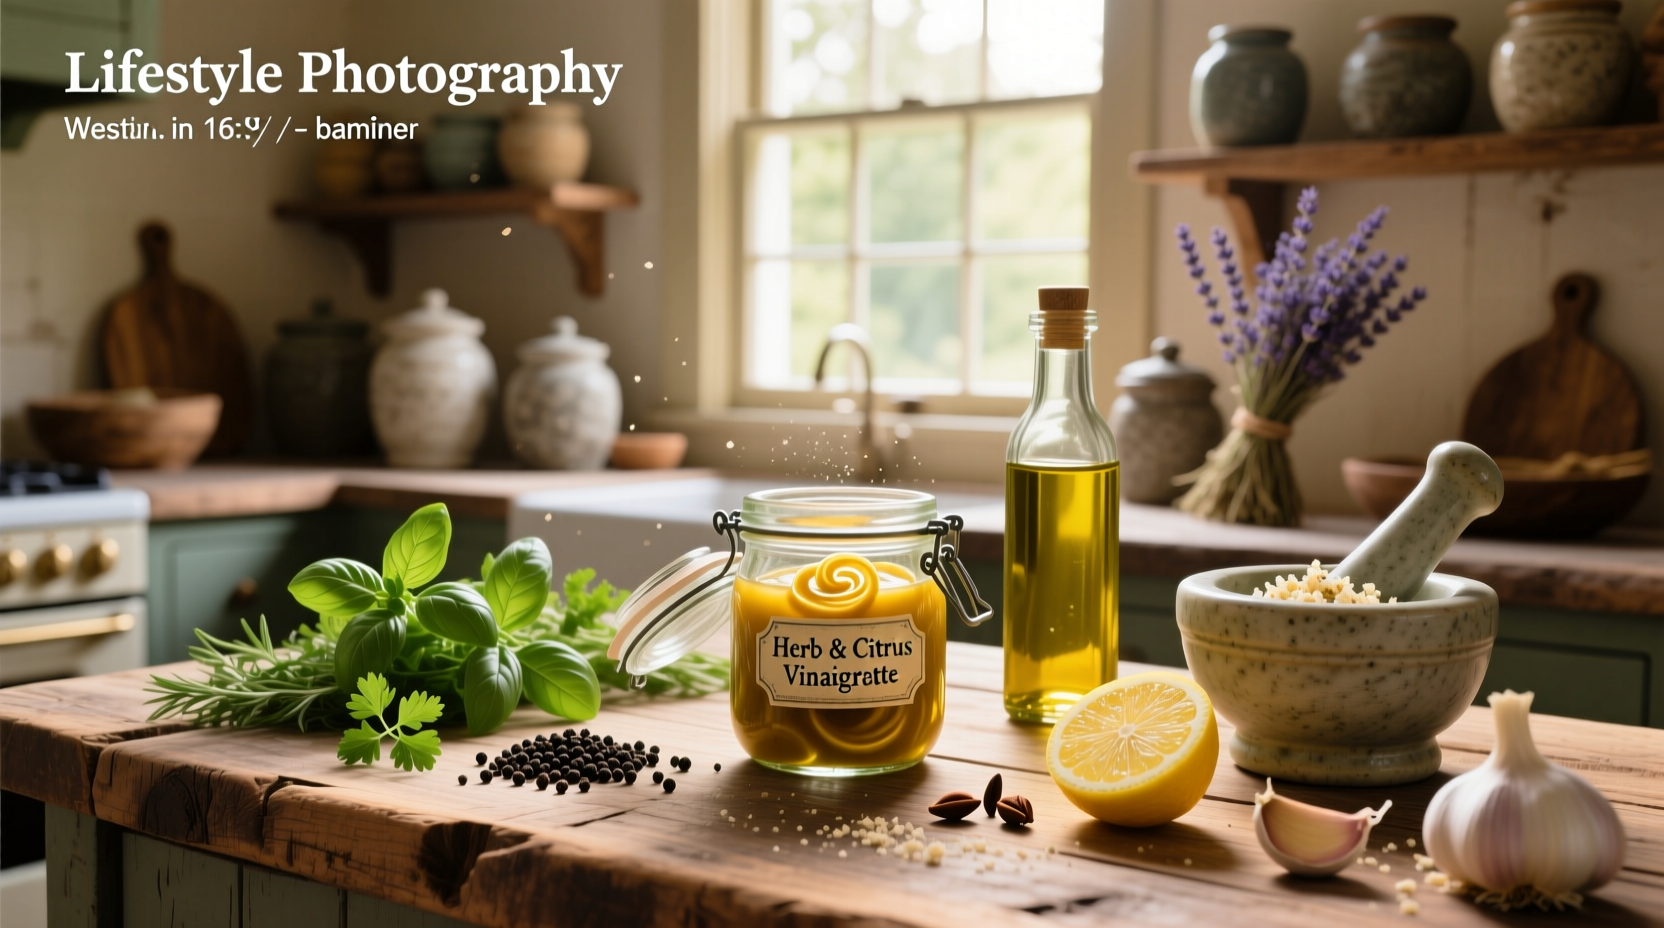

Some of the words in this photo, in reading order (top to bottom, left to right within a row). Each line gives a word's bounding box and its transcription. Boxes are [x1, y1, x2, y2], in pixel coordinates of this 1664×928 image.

[772, 635, 823, 659] Herb
[829, 638, 847, 660] &
[852, 637, 913, 659] Citrus
